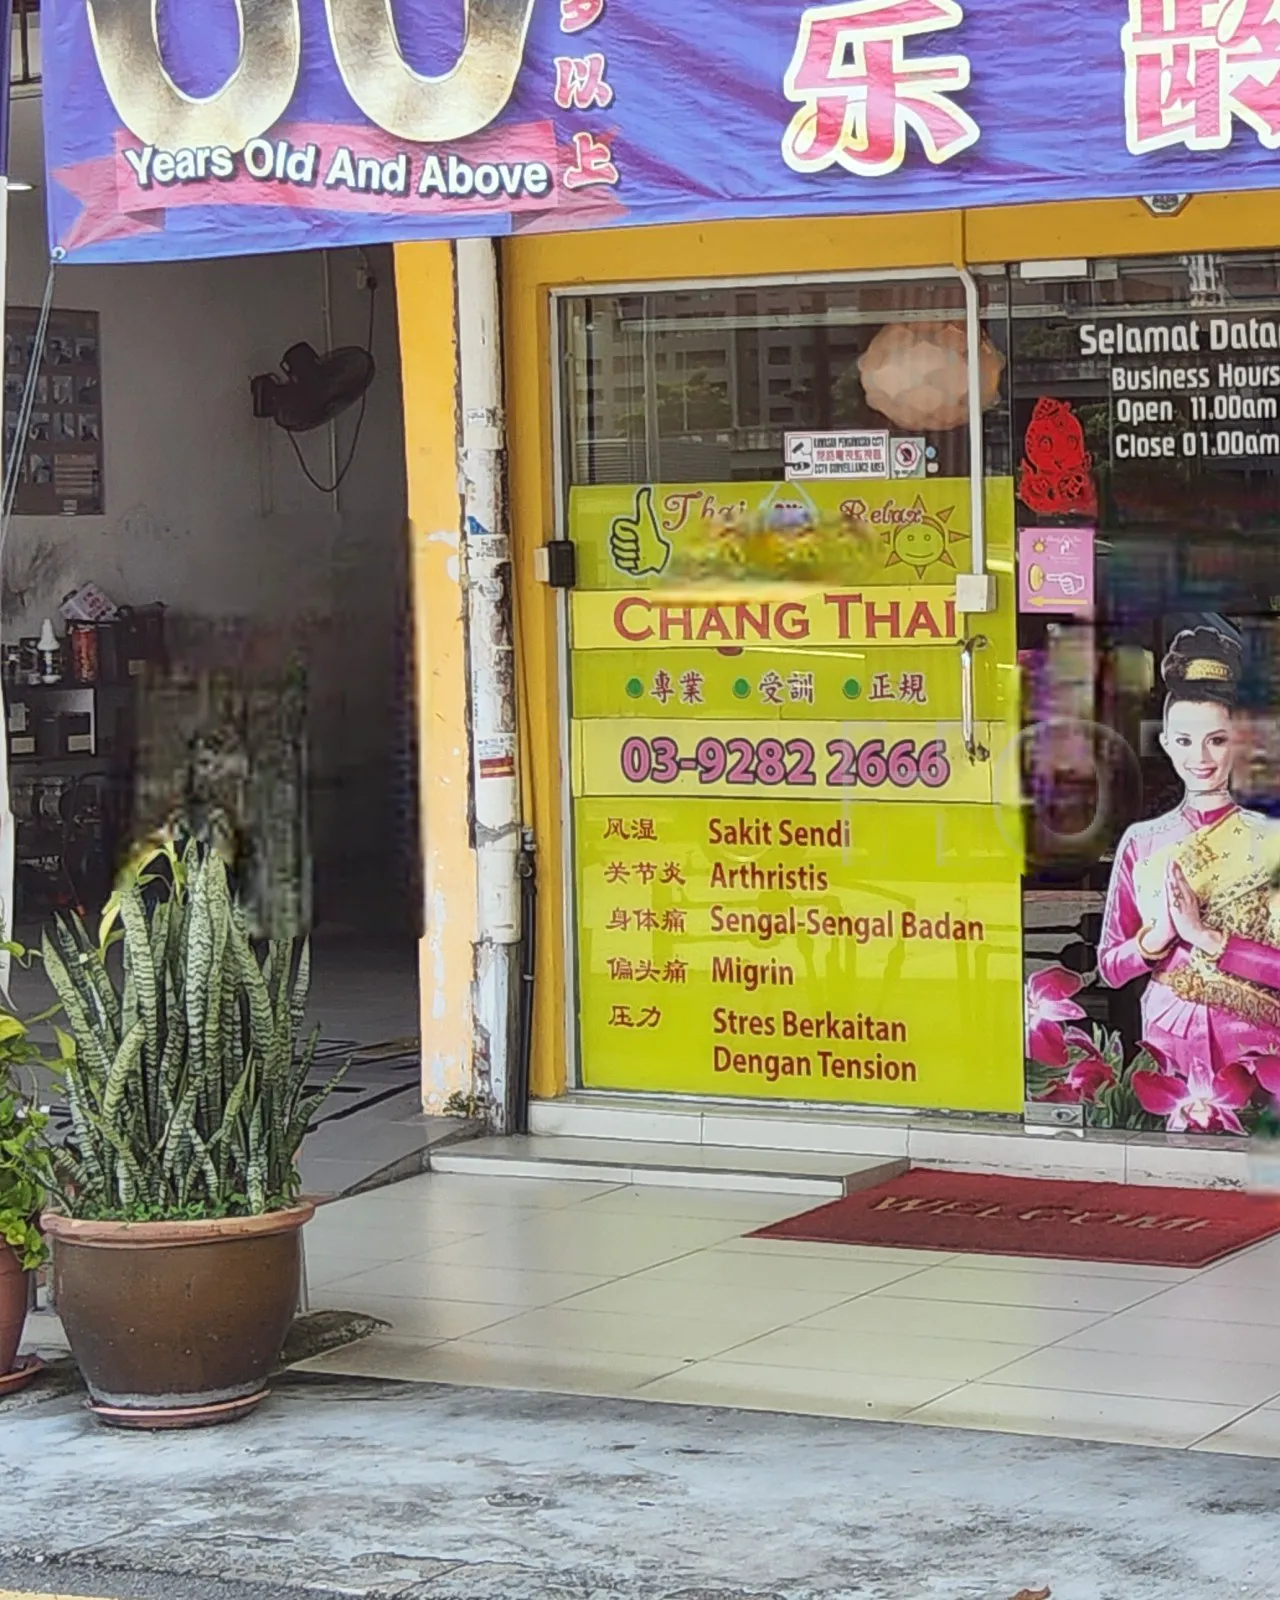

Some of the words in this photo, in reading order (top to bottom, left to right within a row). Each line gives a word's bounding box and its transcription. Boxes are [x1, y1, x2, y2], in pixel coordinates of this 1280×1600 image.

[124, 142, 234, 188] Years
[243, 137, 315, 184] Old
[325, 147, 407, 192] And
[418, 152, 549, 197] Above
[1079, 319, 1200, 355] Selamat
[1111, 365, 1211, 392] Business
[1116, 397, 1174, 427] Open
[1190, 394, 1278, 422] 11.00am
[1115, 433, 1176, 459] Close
[613, 596, 810, 643] CHANG
[824, 593, 957, 640] THAI
[758, 670, 814, 704] 受訓
[868, 673, 927, 703] 正規
[621, 737, 816, 788] 03-9282
[826, 738, 951, 787] 2666
[603, 817, 658, 841] 风湿
[708, 818, 772, 848] Sakit
[778, 818, 851, 849] Sendi
[603, 861, 687, 886] 关节炎
[709, 862, 829, 892] Arthristis
[604, 906, 688, 933] 身体痛
[710, 905, 895, 944] Sengal-Sengal
[900, 912, 985, 941] Badan
[606, 957, 689, 985] 偏头痛
[711, 955, 795, 991] Migrin
[608, 1005, 662, 1028] 压力
[712, 1008, 776, 1037] Stres
[782, 1011, 908, 1043] Berkaitan
[712, 1046, 813, 1083] Dengan
[817, 1051, 918, 1083] Tension
